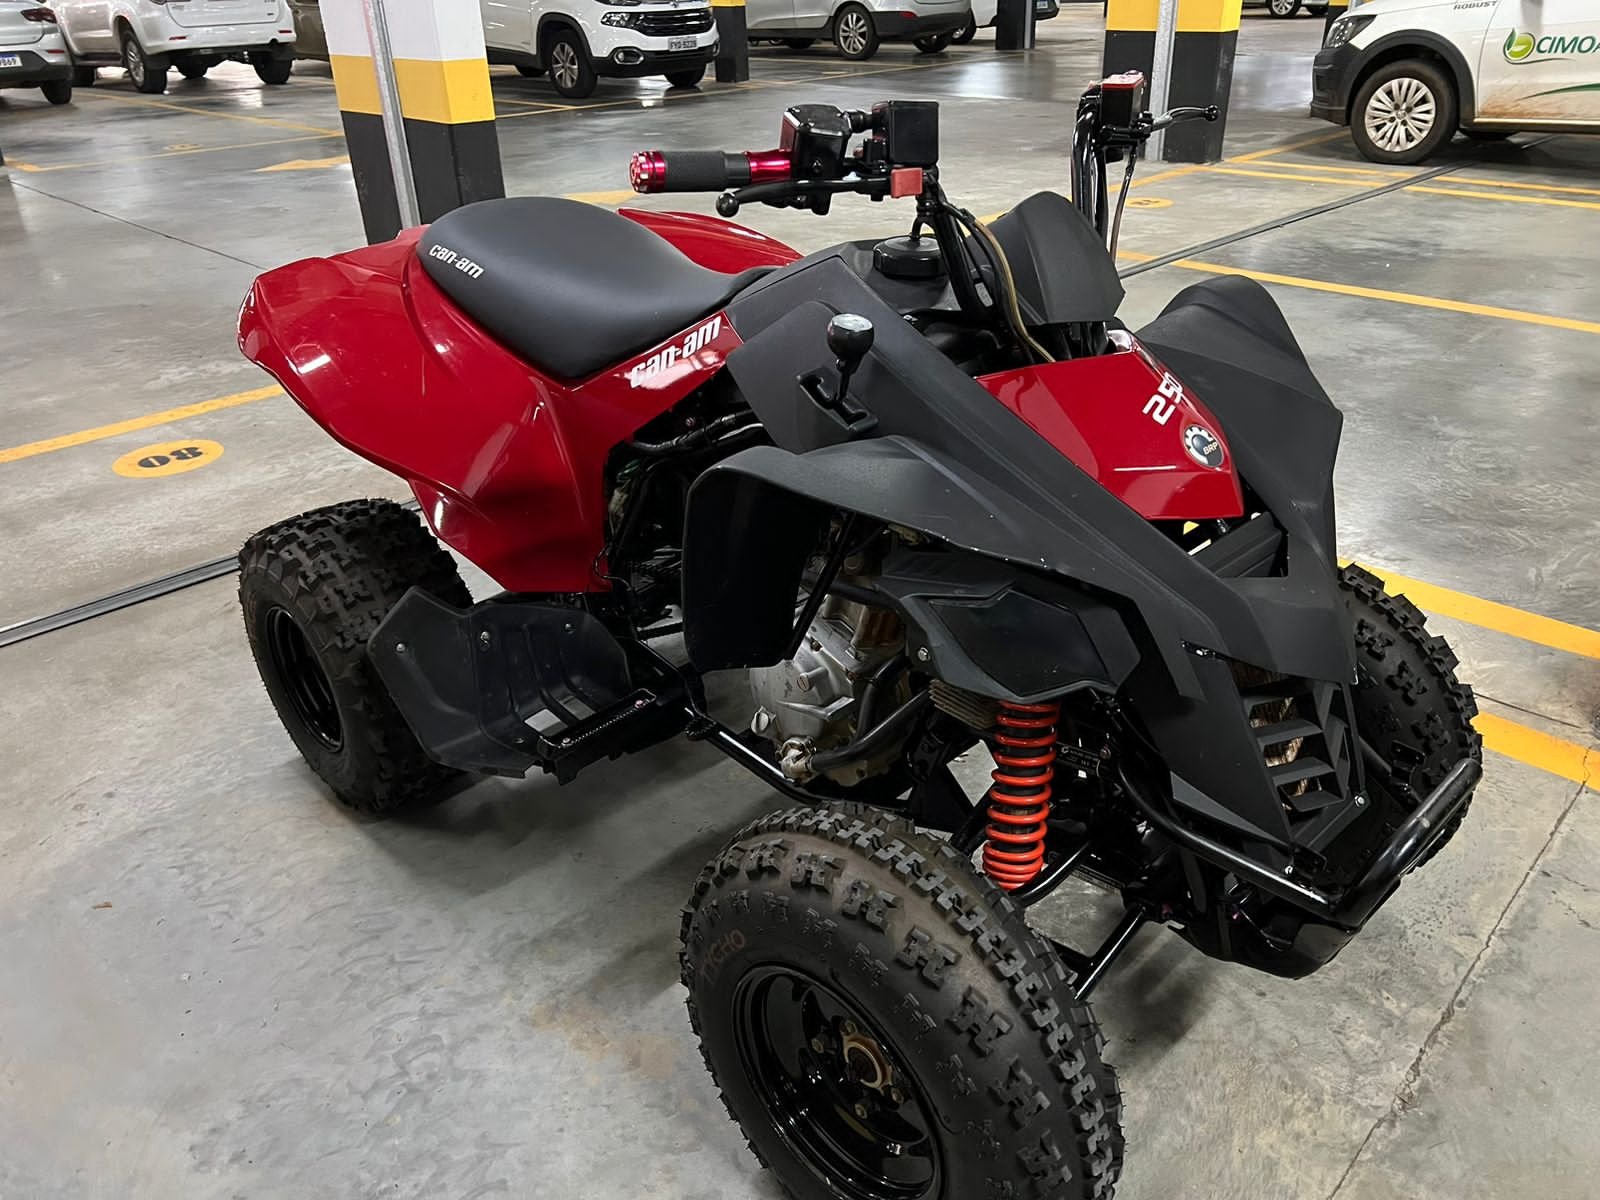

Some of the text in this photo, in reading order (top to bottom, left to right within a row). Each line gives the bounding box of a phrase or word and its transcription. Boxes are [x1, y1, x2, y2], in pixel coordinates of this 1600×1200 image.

[429, 244, 484, 279] can-am
[630, 315, 722, 389] can-am
[1202, 441, 1218, 455] BRP
